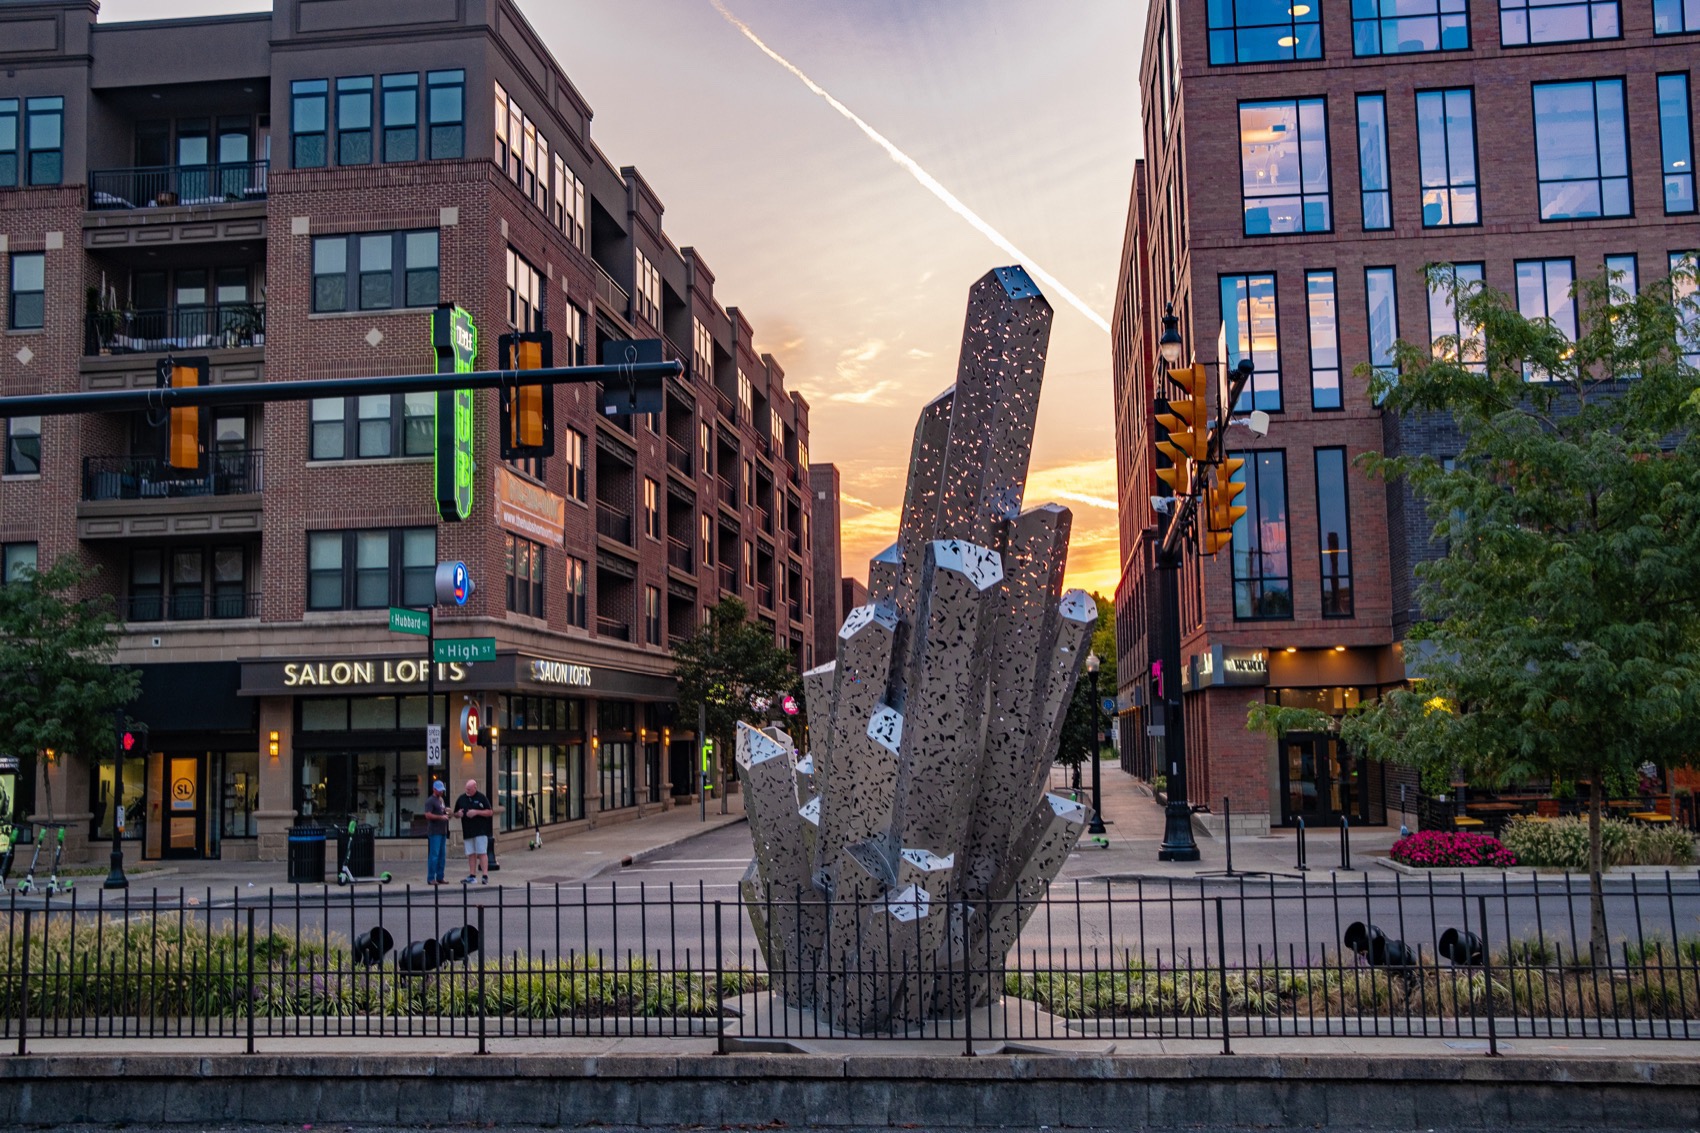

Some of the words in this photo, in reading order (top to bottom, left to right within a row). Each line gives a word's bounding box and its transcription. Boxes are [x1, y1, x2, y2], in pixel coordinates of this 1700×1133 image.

[457, 567, 464, 586] P
[395, 614, 421, 629] Hubbard
[448, 644, 479, 660] High
[284, 661, 374, 686] SALON
[384, 659, 466, 683] LOFTS
[540, 659, 568, 684] SALON
[569, 664, 592, 687] LOFTS
[428, 728, 440, 737] SPEED
[468, 715, 479, 736] SL
[430, 737, 439, 745] LIMIT
[177, 784, 190, 795] SL
